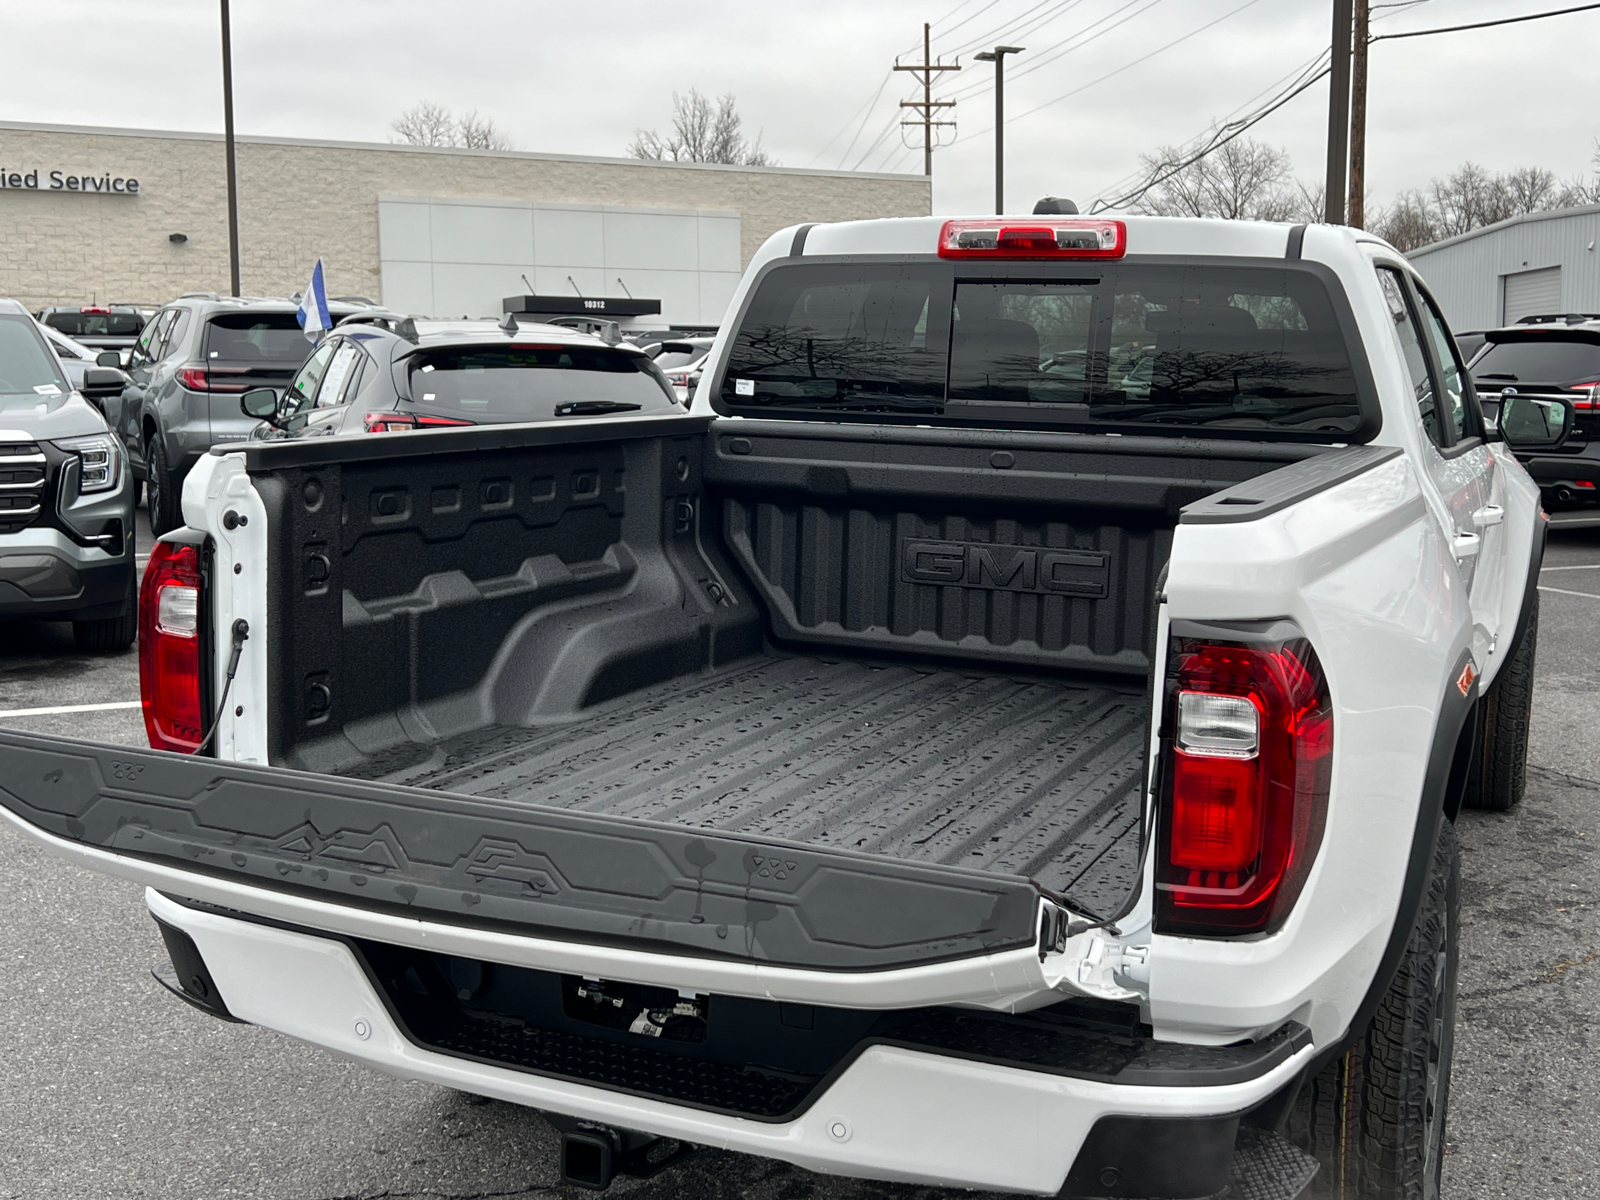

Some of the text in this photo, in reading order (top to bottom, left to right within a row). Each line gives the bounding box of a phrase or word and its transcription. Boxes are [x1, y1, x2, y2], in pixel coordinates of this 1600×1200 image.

[1, 168, 139, 193] ied Service
[905, 543, 1104, 594] GMC
